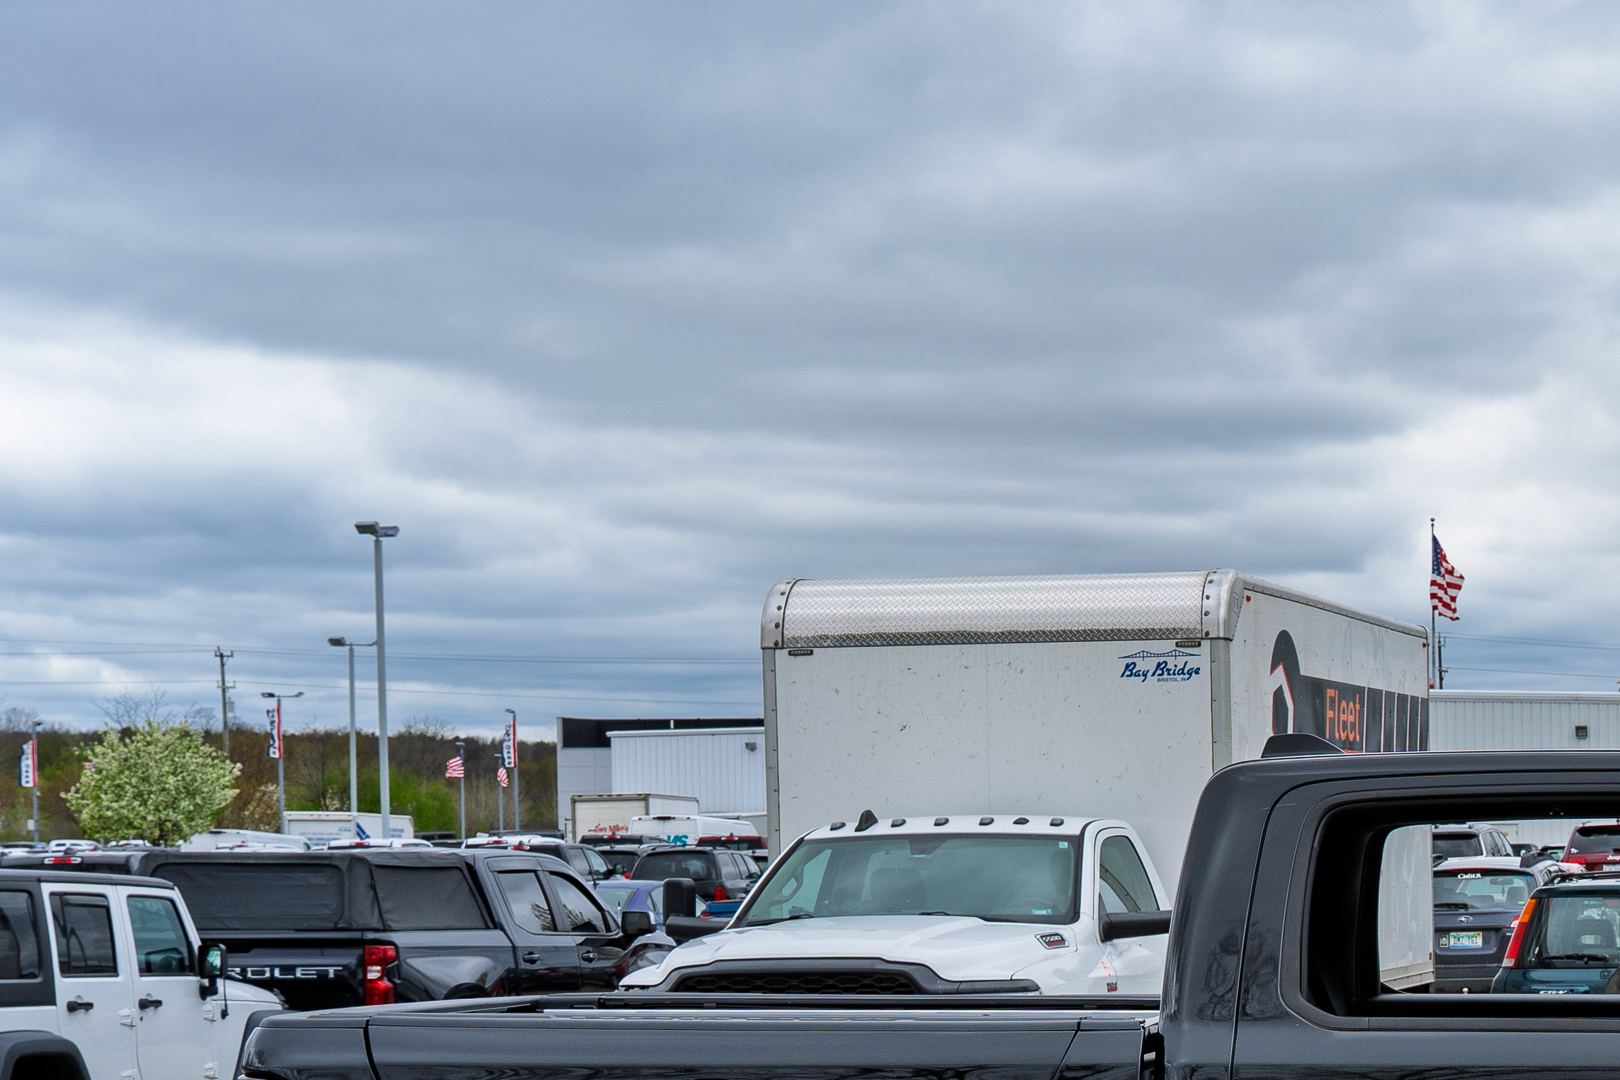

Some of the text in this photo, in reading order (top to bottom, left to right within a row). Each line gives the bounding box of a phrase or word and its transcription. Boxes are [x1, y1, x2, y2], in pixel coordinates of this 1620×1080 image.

[1120, 660, 1201, 683] Bay Bridge
[1326, 688, 1360, 742] Fleet
